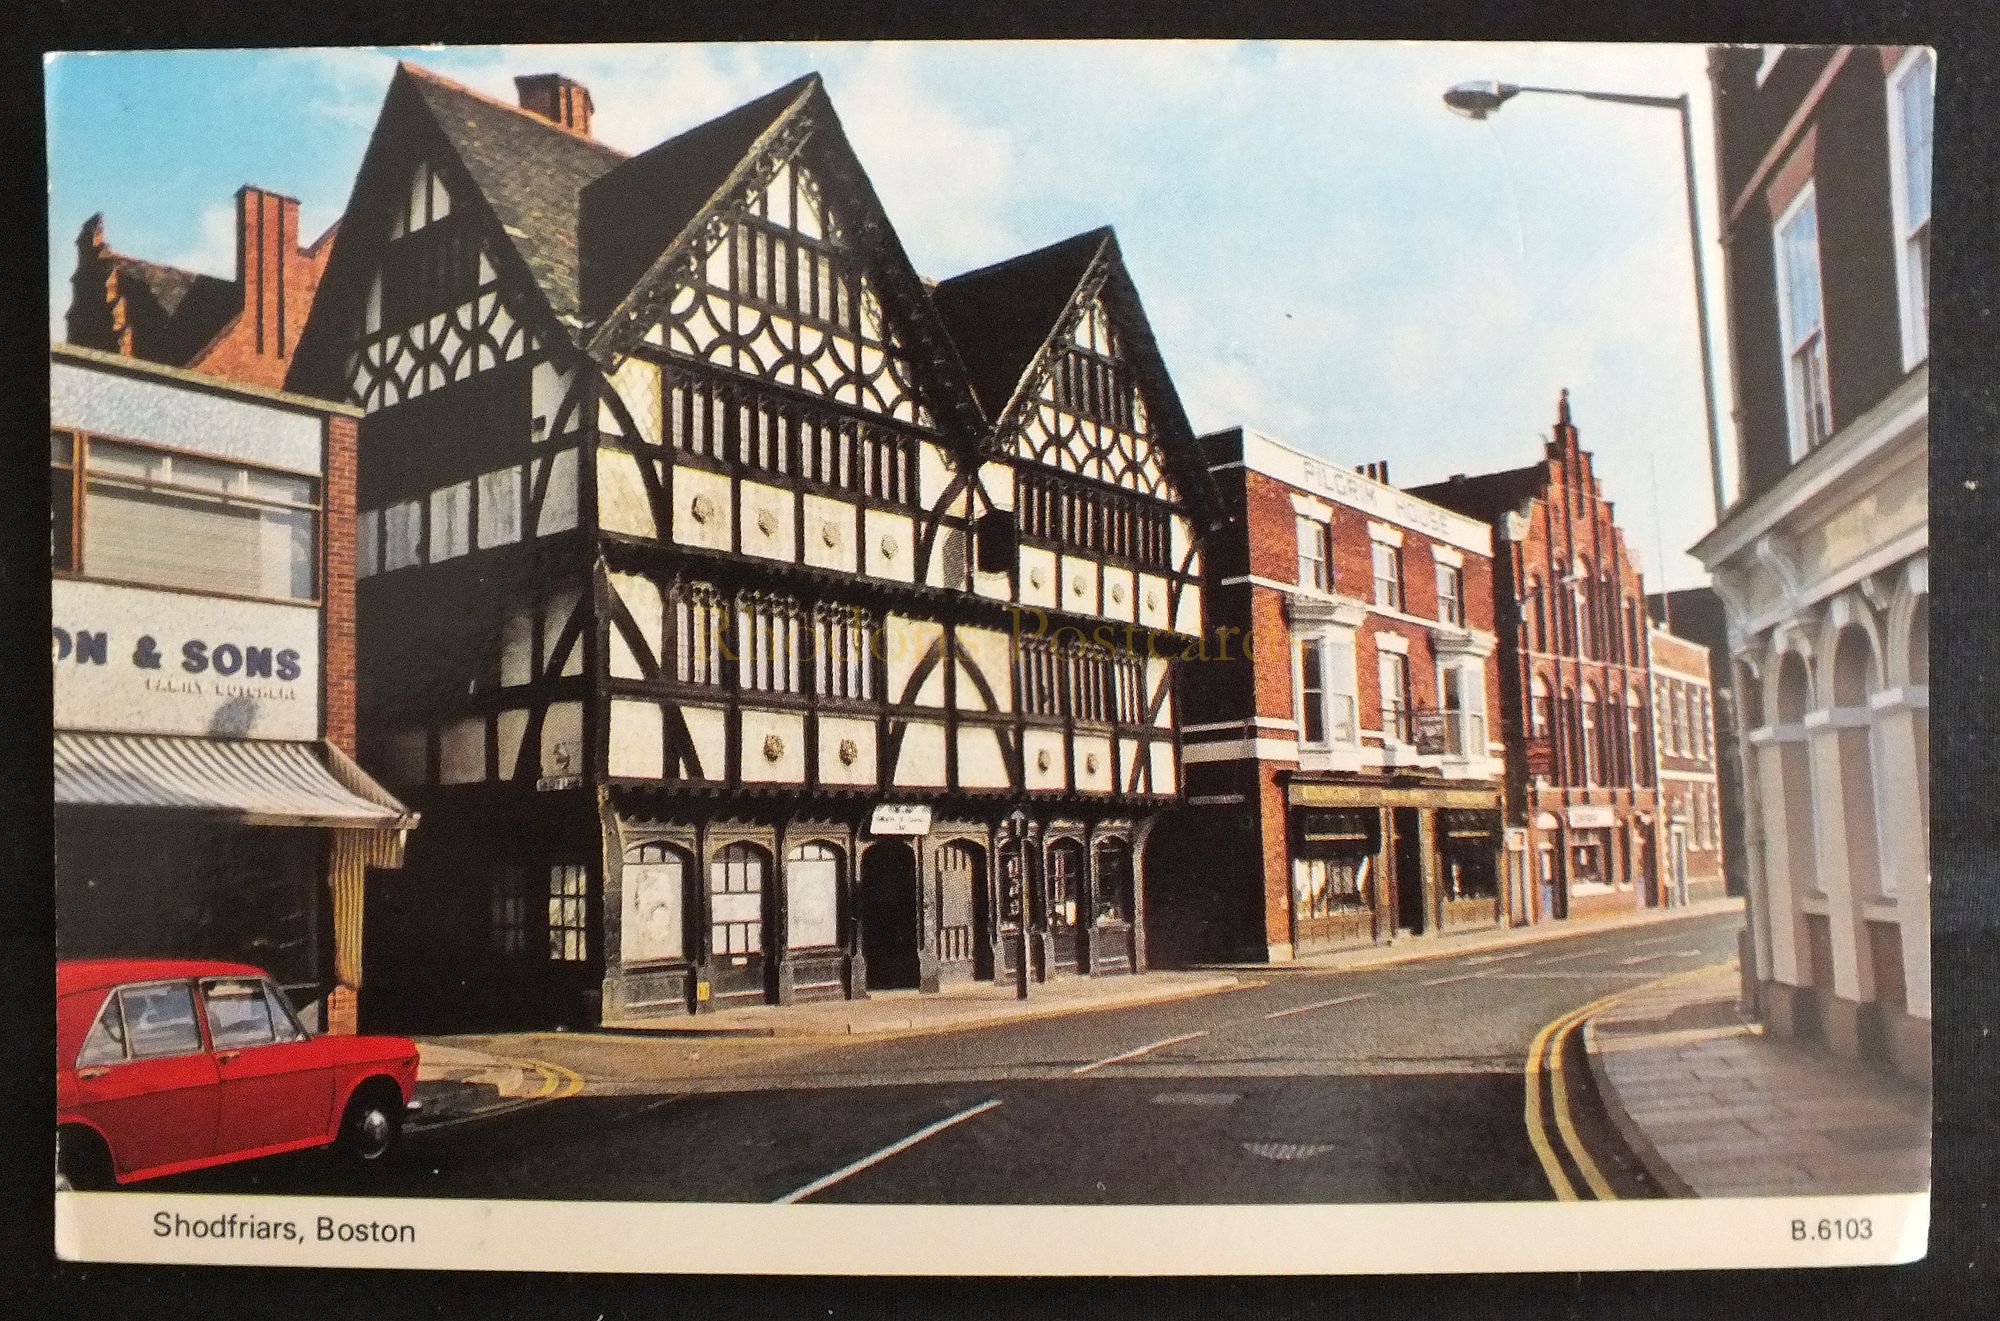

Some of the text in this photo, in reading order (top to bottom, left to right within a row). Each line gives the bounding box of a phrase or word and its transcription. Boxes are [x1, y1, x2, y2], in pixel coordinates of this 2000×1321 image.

[132, 635, 162, 670] &
[181, 639, 301, 681] SONS
[153, 1211, 415, 1244] Shodfriars, Boston
[1791, 1218, 1873, 1240] B.6103
